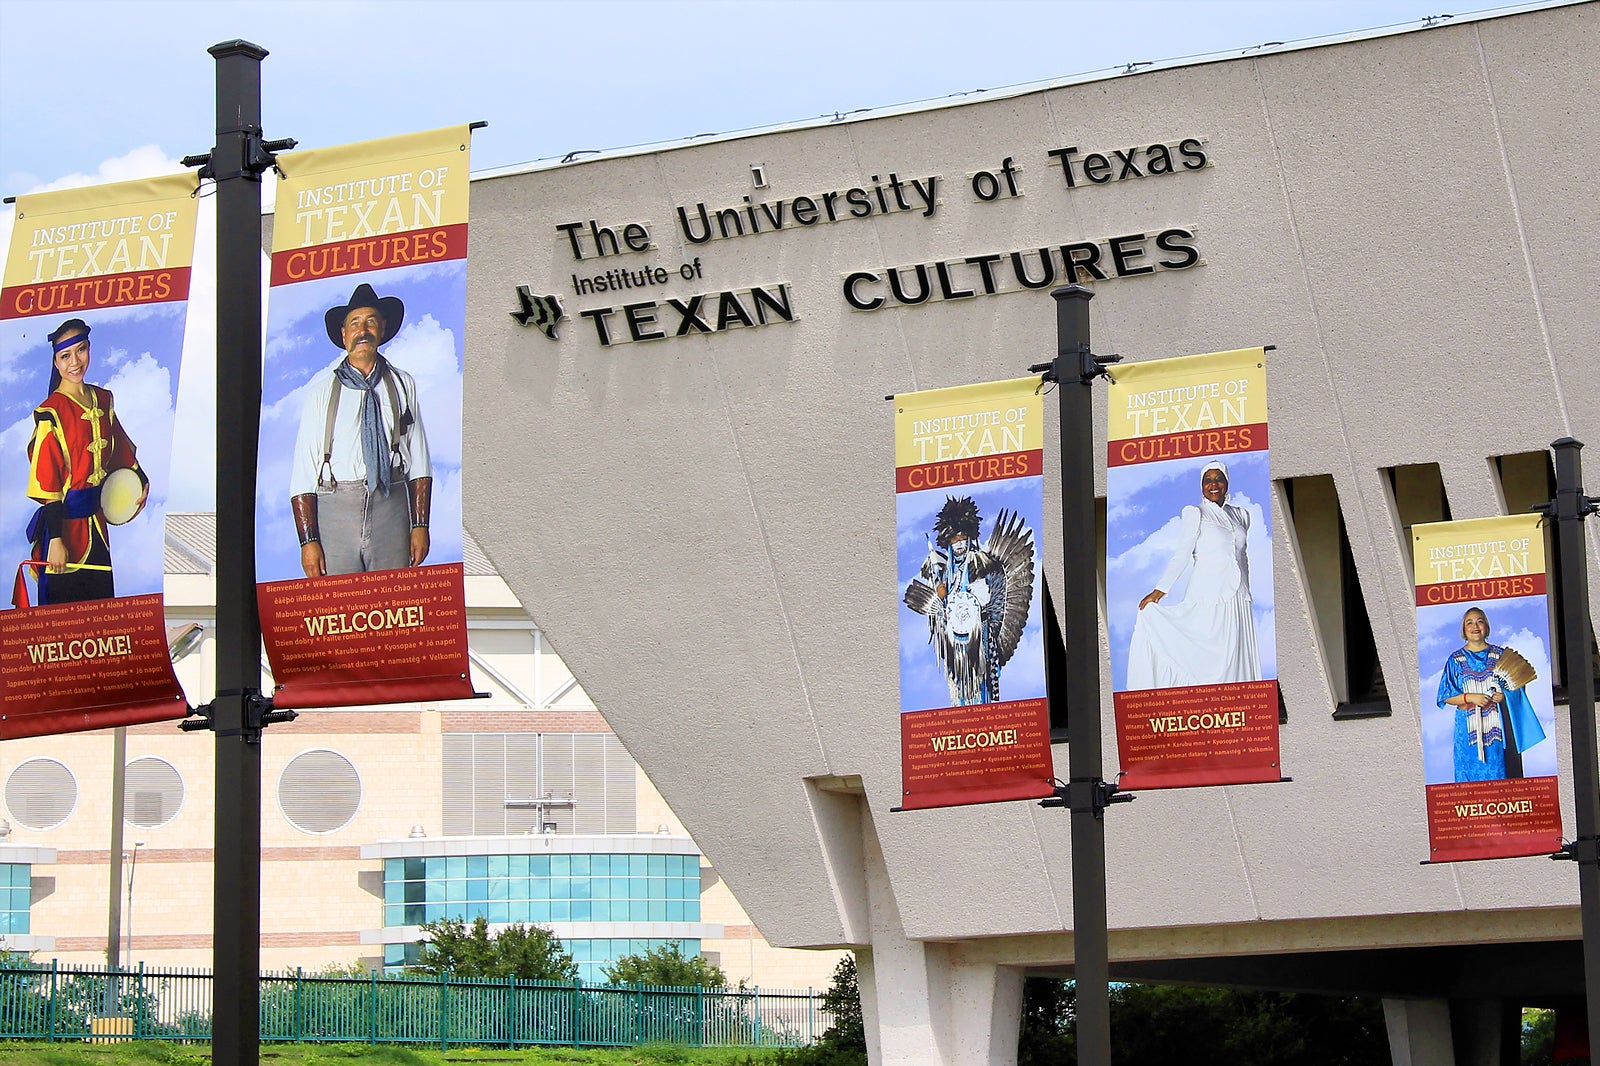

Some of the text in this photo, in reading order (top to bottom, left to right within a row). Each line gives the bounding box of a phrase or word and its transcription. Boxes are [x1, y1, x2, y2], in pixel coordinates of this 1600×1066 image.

[297, 167, 449, 209] INSTITUTE OF
[556, 138, 1208, 259] The University of Texas
[32, 212, 177, 247] INSTITUTE OF
[296, 190, 445, 247] TEXAN
[29, 233, 174, 283] TEXAN
[287, 231, 447, 279] CULTURES
[572, 257, 703, 295] Institute of
[580, 228, 1201, 346] TEXAN CULTURES
[15, 273, 171, 314] CULTURES
[1127, 379, 1248, 409] INSTITUTE OF
[913, 407, 1027, 436] INSTITUTE OF
[1127, 397, 1247, 438] TEXAN
[913, 424, 1026, 464] TEXAN
[1121, 428, 1252, 462] CULTURES
[909, 454, 1028, 488] CULTURES
[1430, 538, 1529, 560] INSTITUTE OF
[266, 583, 304, 592] Bienvenido
[313, 578, 353, 588] Wilkommen
[362, 573, 387, 582] Shalom
[427, 567, 458, 576] Akwaaba
[1430, 552, 1529, 583] TEXAN
[332, 588, 371, 598] Bienvenuto
[1427, 577, 1534, 603] CULTURES
[0, 612, 27, 620] envenido
[35, 607, 69, 616] Wilkommen
[76, 604, 98, 613] Shalom
[276, 610, 305, 618] Mabuhay
[315, 606, 337, 614] Vitejte
[371, 600, 382, 610] yuk
[392, 597, 431, 608] Benvinguts
[304, 606, 424, 637] WELCOME!
[52, 618, 84, 627] Bienvenuto
[273, 625, 297, 633] Witamy
[3, 637, 29, 646] Mabuhay
[27, 635, 132, 664] WELCOME!
[295, 637, 314, 646] dobry
[384, 642, 417, 651] Kyosopae
[435, 638, 455, 647] napot
[1149, 712, 1245, 733] WELCOME!
[931, 729, 1018, 752] WELCOME!
[1455, 801, 1533, 817] WELCOME!
